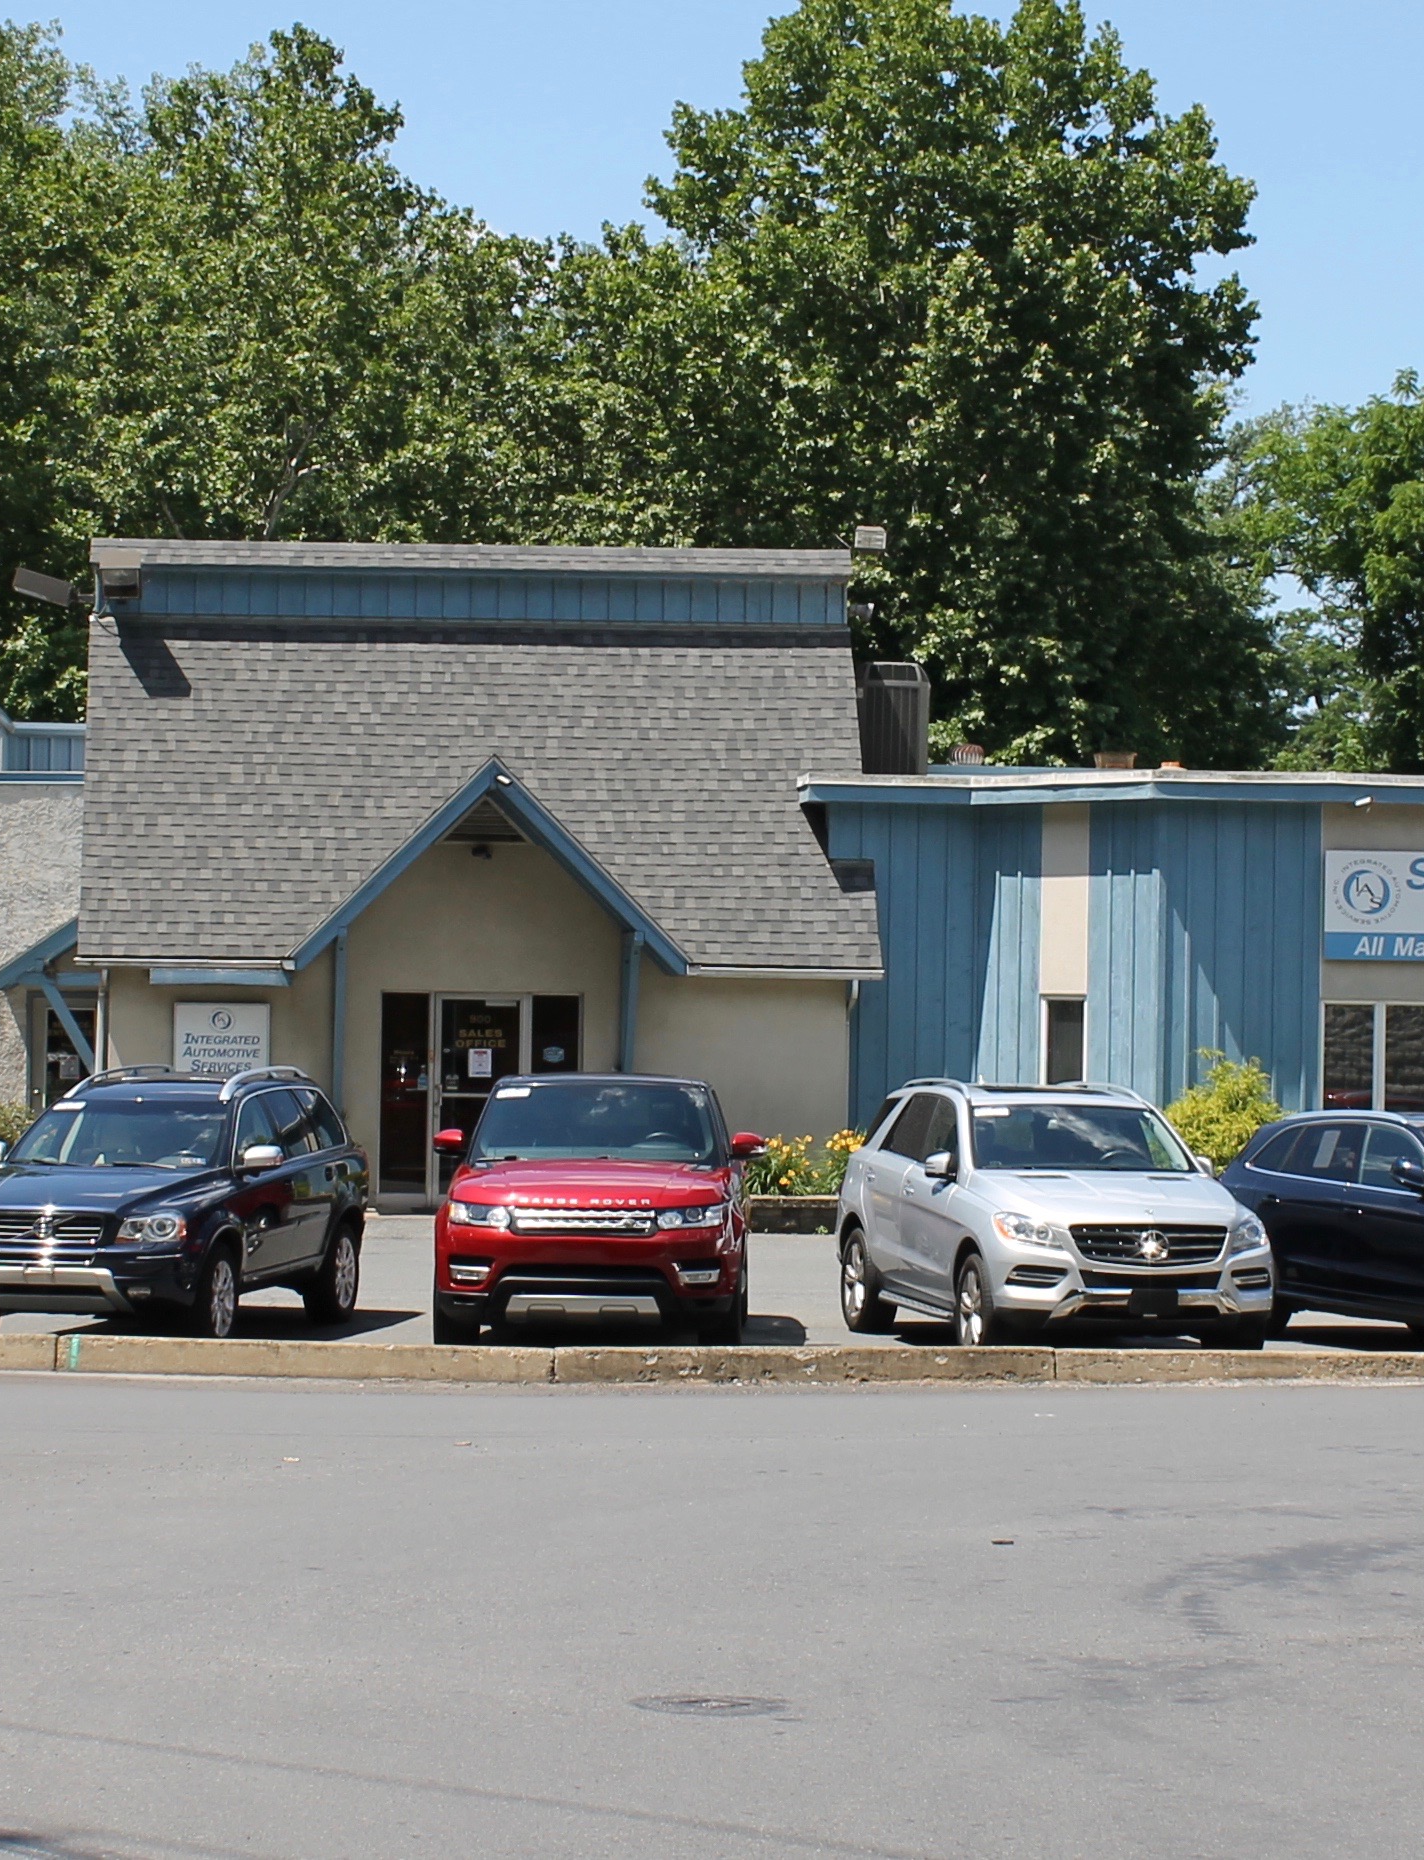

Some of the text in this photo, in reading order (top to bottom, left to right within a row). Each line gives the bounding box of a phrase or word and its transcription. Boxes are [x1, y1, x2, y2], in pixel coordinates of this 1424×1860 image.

[1353, 936, 1387, 957] All
[183, 1033, 261, 1045] INTEGRATED
[459, 1029, 503, 1038] SALES
[455, 1039, 506, 1048] OFFICE
[182, 1046, 261, 1058] AUTOMOTIVE
[190, 1059, 253, 1073] SERVICES
[589, 1198, 651, 1206] ROVER
